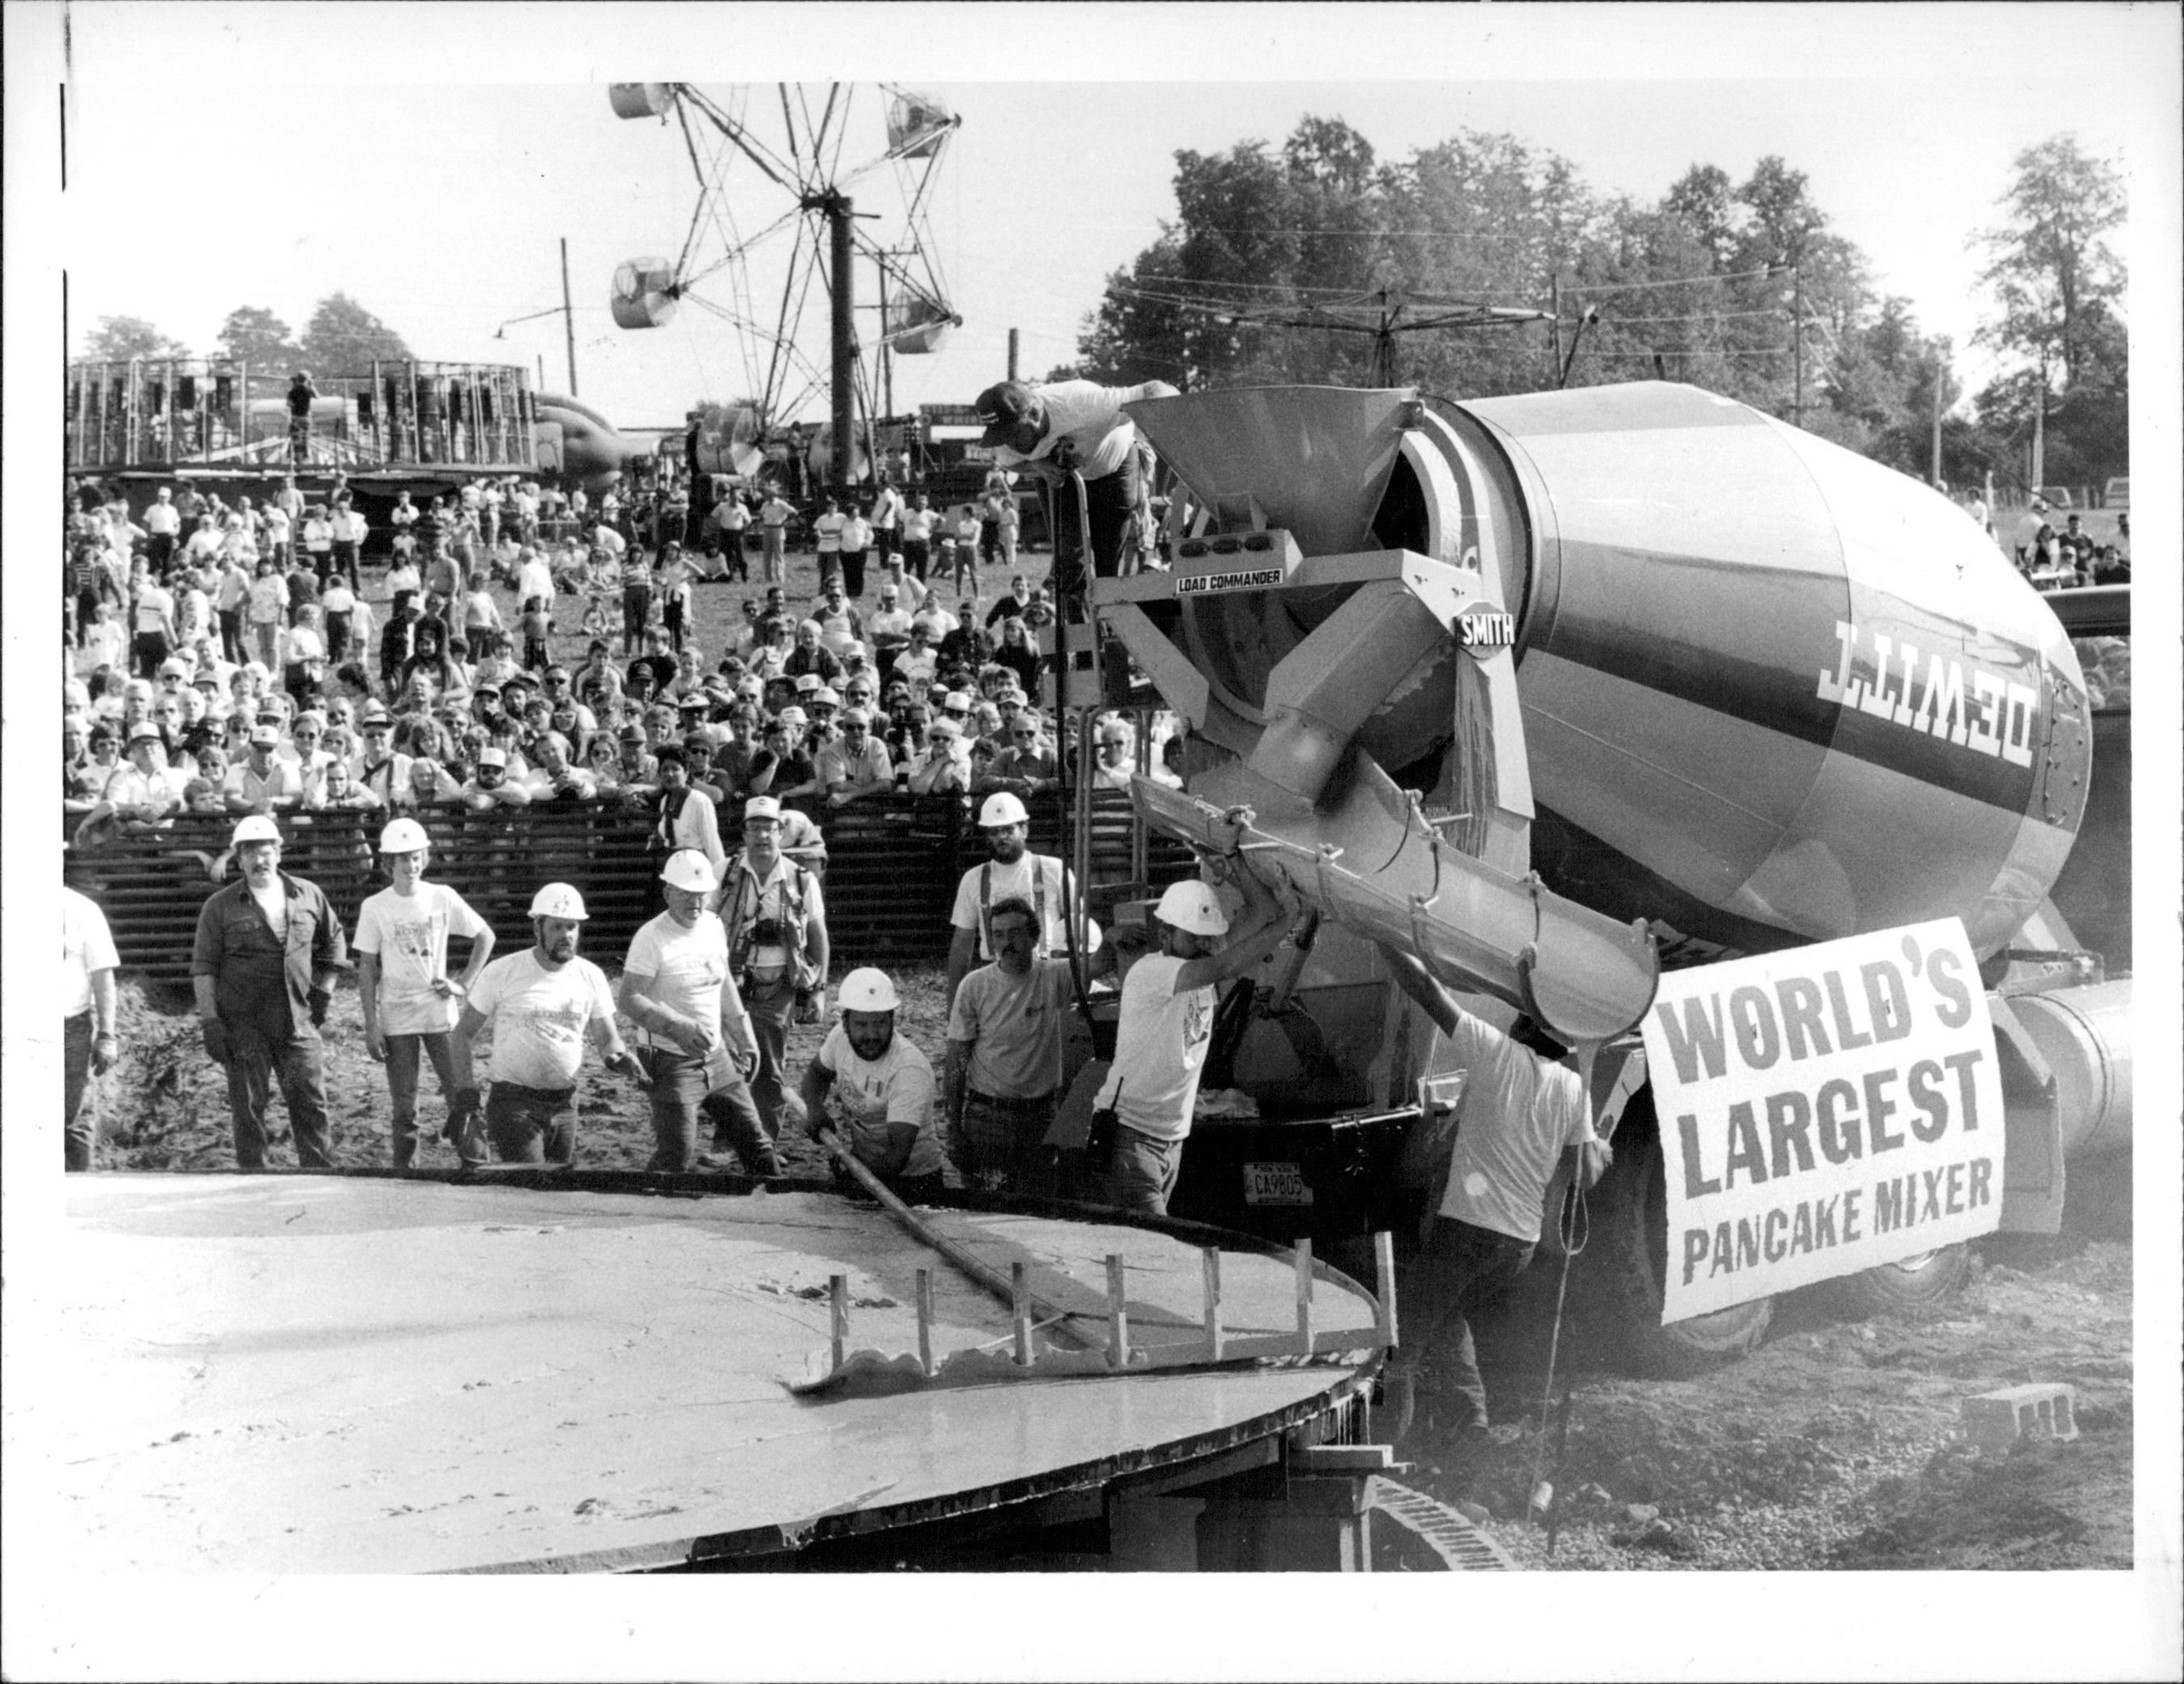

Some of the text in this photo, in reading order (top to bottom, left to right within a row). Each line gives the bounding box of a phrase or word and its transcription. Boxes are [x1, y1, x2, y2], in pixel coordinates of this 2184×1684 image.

[1179, 569, 1281, 592] LOAD COMMANDER
[1461, 613, 1515, 645] SMITH
[1816, 620, 2037, 768] DEWITT
[1655, 934, 1972, 1085] WORLD'S
[1255, 1174, 1303, 1196] CA9805
[1677, 1049, 1983, 1200] LARGEST
[1682, 1157, 1993, 1286] PANCAKE MIXER
